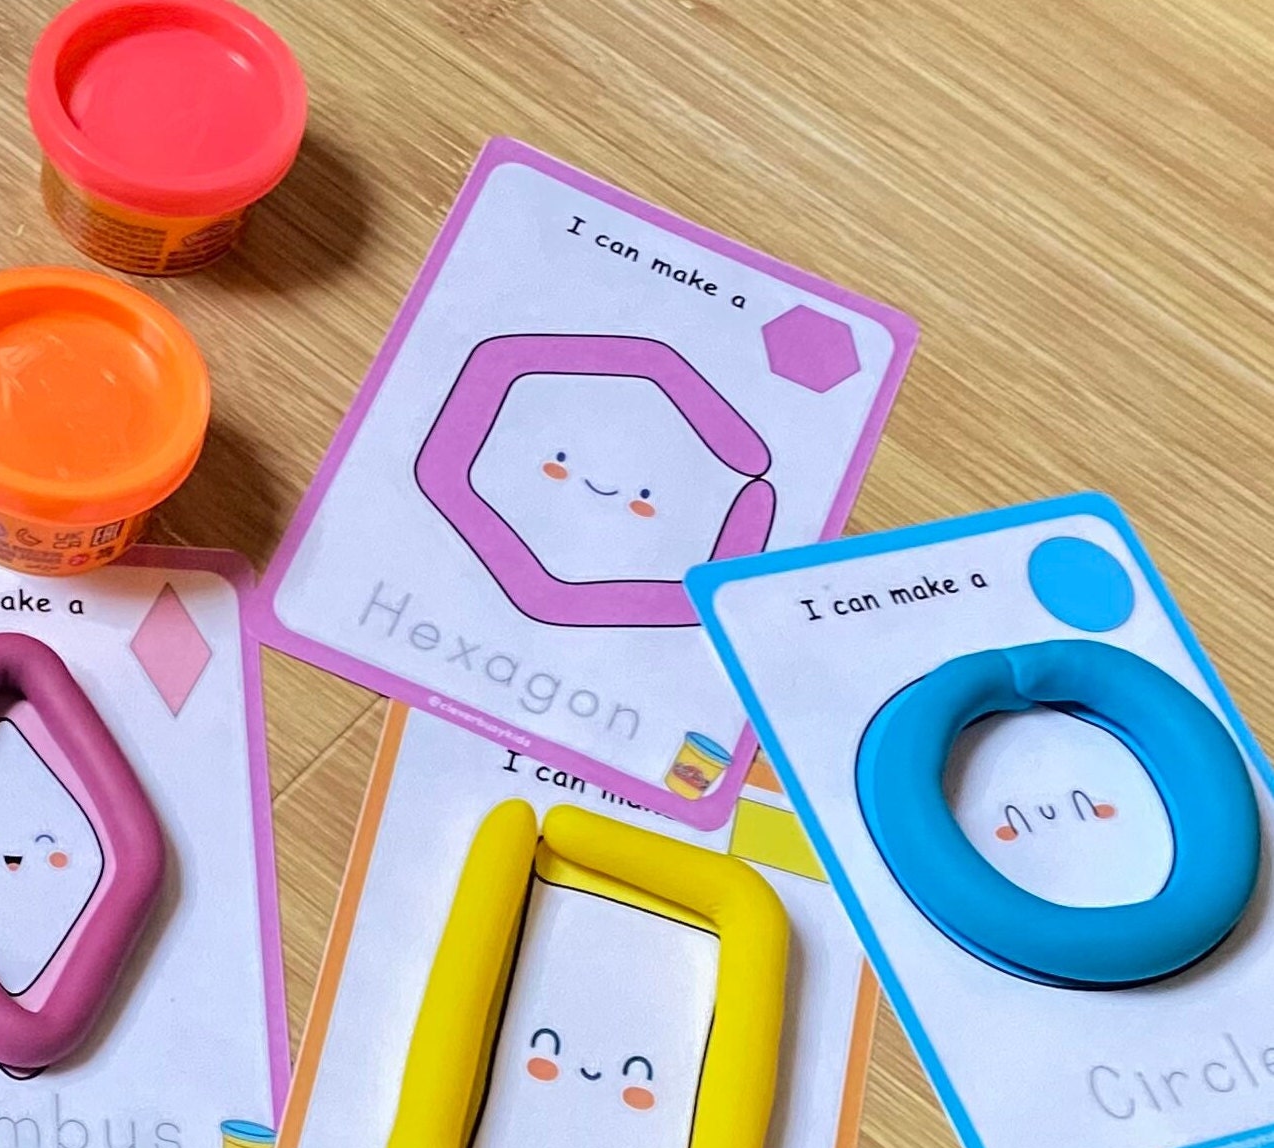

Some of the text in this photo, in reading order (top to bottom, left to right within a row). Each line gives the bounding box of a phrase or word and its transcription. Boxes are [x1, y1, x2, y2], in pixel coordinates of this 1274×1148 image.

[568, 217, 745, 308] I can make a
[70, 600, 83, 614] a
[801, 574, 987, 620] I can make a
[357, 579, 642, 740] Hexagon
[503, 749, 522, 773] I
